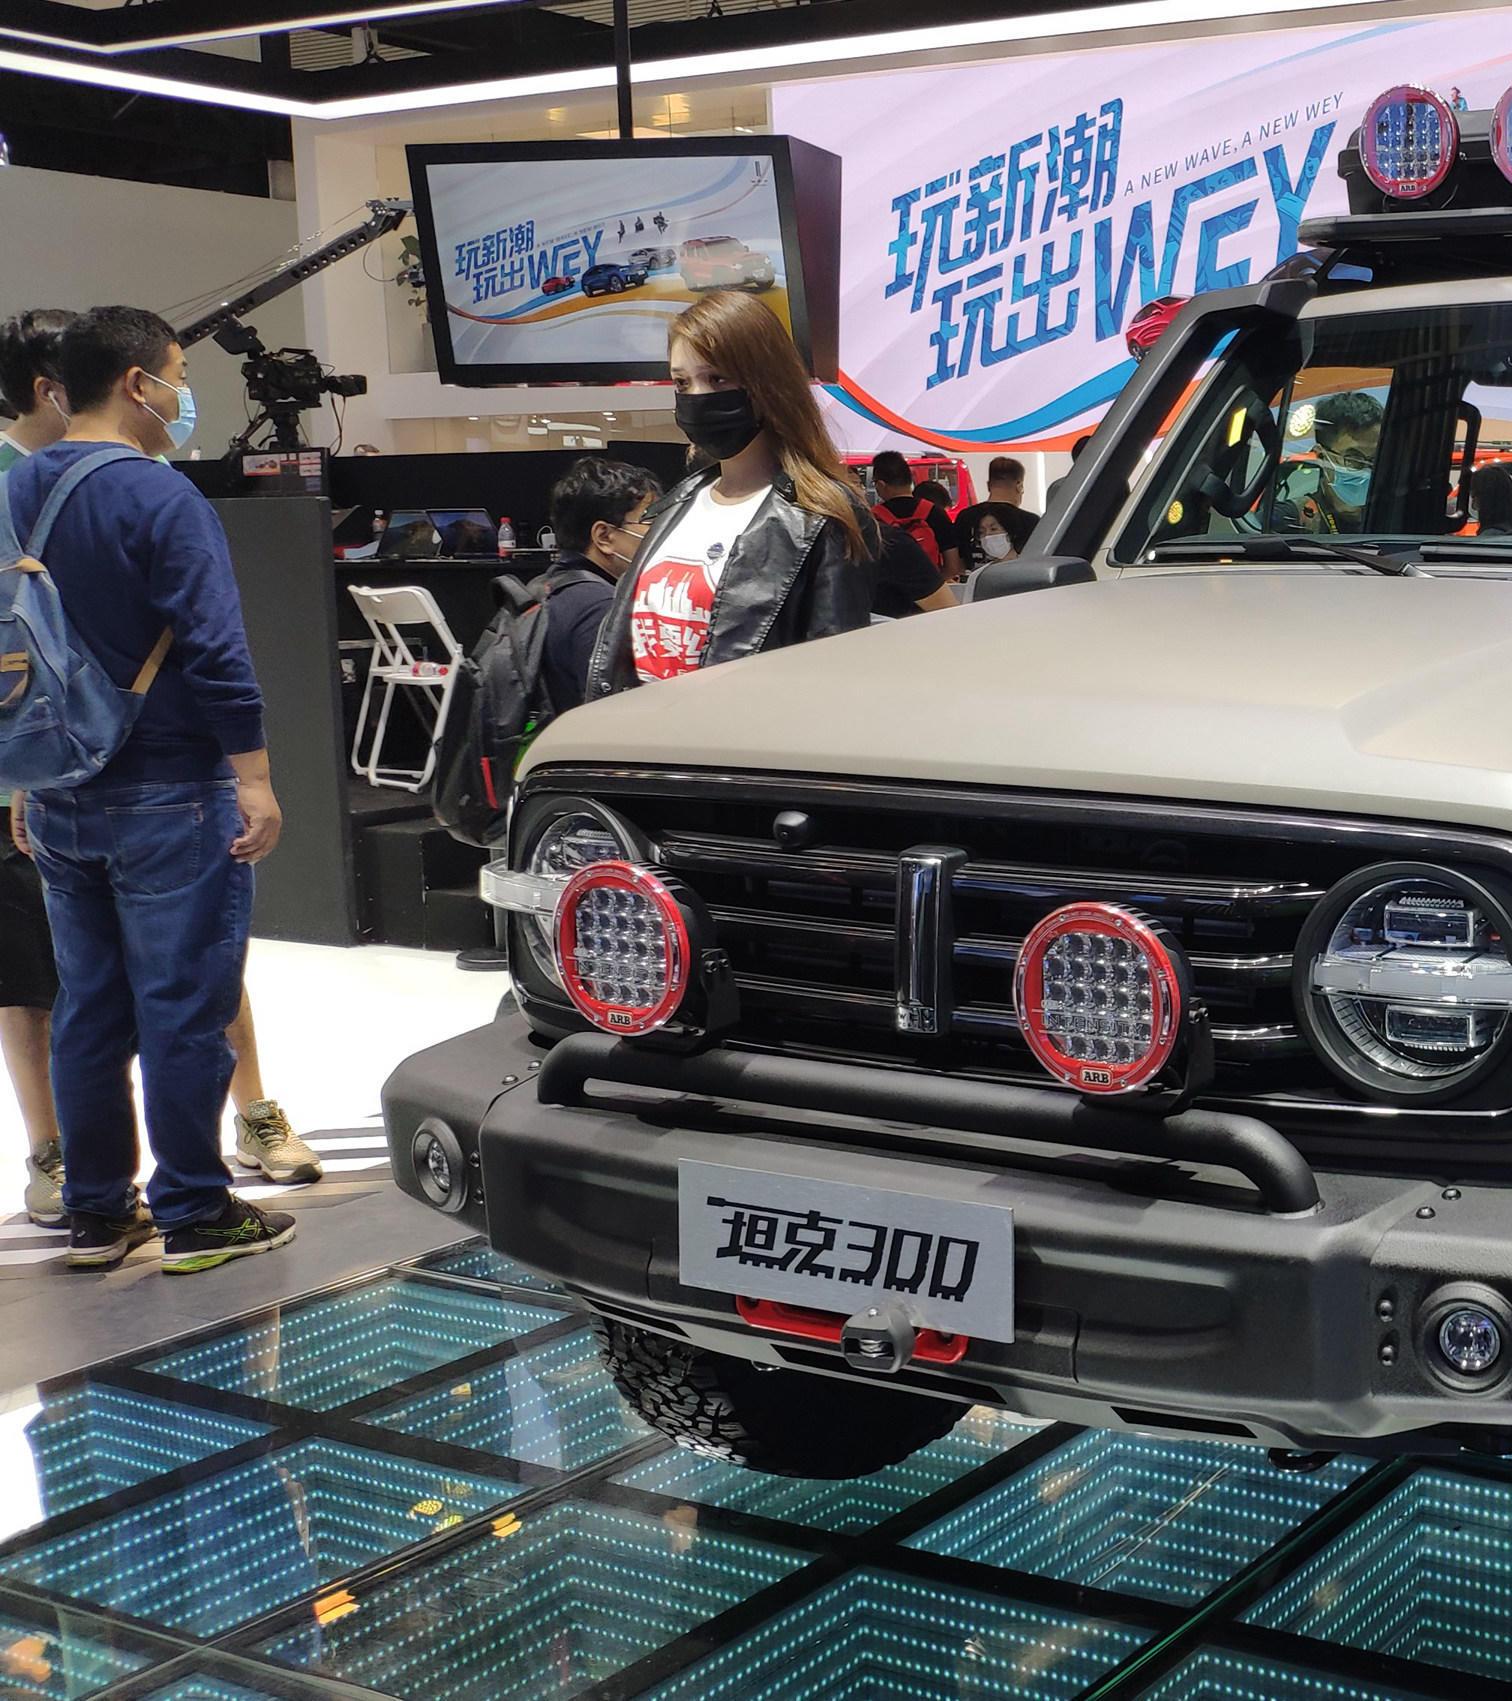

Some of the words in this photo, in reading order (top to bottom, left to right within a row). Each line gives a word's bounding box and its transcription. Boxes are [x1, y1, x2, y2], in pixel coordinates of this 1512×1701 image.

[1124, 180, 1134, 196] A
[1141, 161, 1178, 189] NEW
[1185, 138, 1238, 171] WAVE,
[1241, 131, 1252, 149] A
[1259, 111, 1298, 141] NEW
[1306, 91, 1344, 121] WEY
[885, 98, 1123, 313] 玩新潮
[455, 220, 534, 281] 玩新潮
[609, 1013, 631, 1025] ARB
[1083, 1071, 1110, 1084] ARB
[707, 1196, 979, 1302] 坦克300
